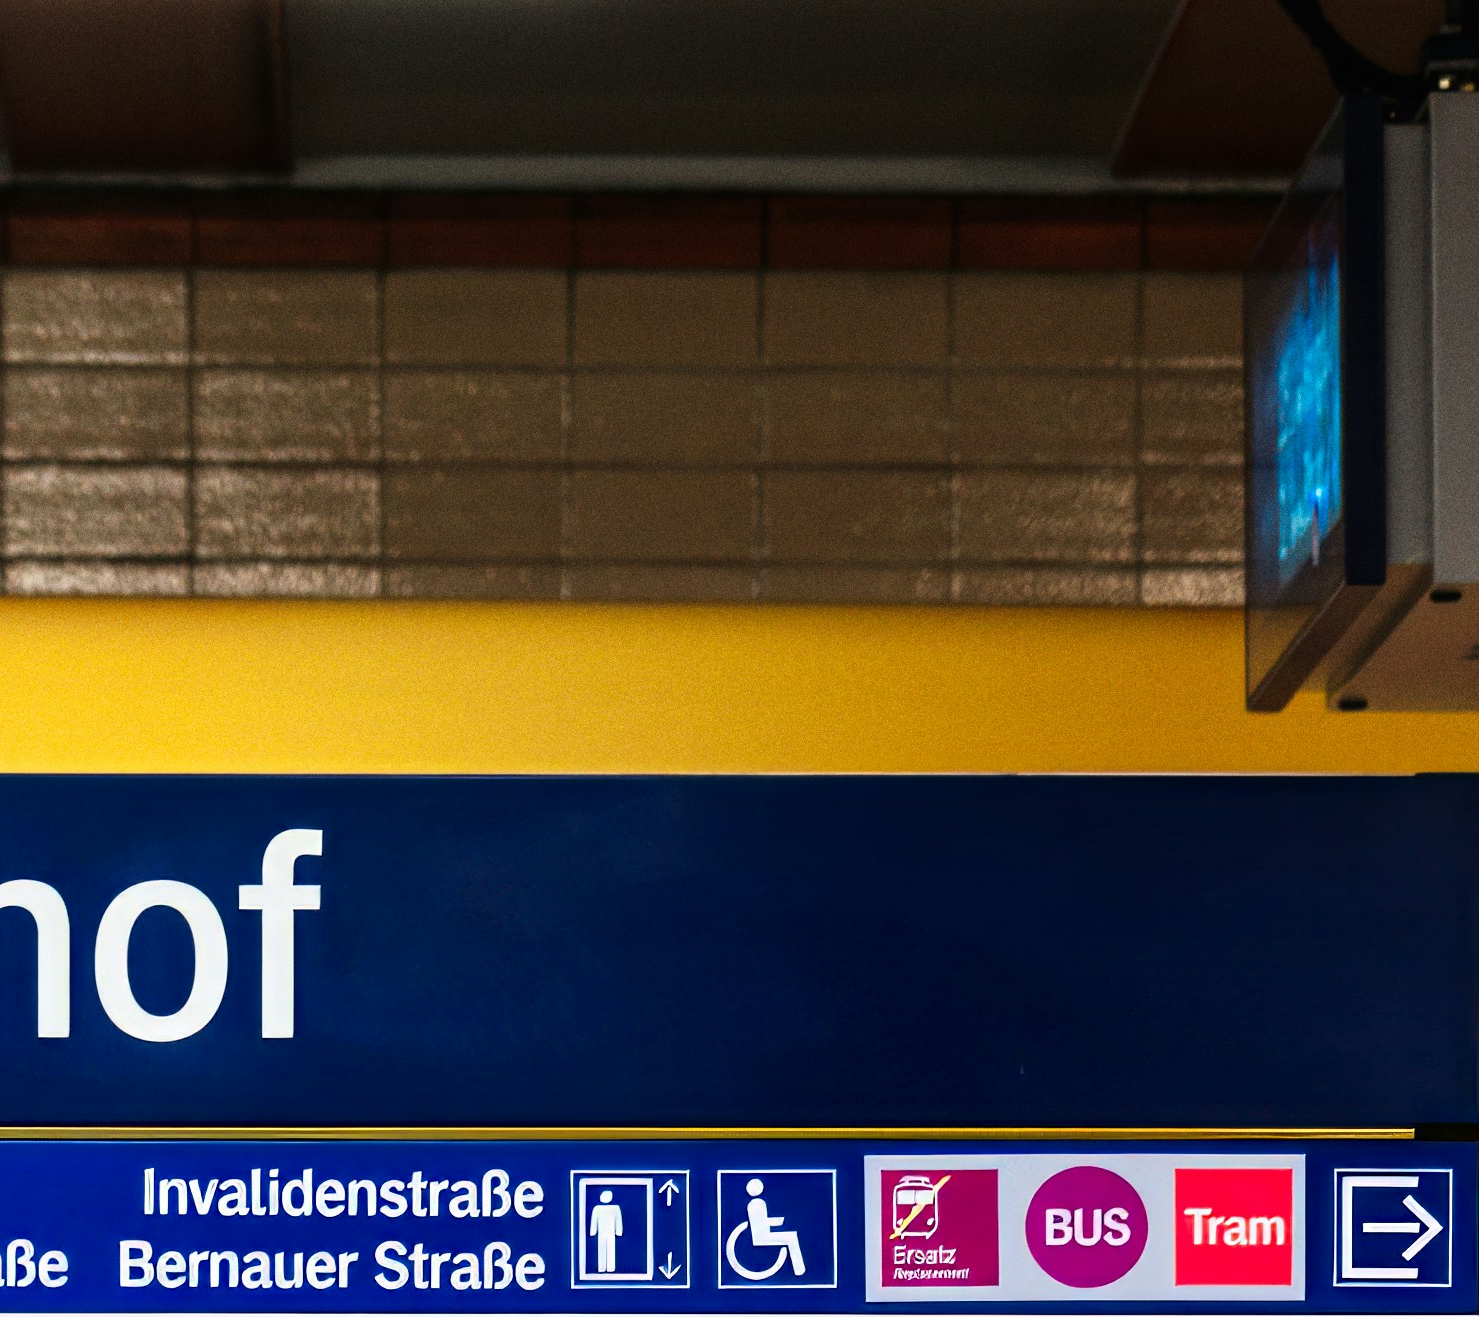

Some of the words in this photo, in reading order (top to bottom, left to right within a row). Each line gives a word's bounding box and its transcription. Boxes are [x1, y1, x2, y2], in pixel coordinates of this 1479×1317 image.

[142, 1166, 545, 1220] Invalidenstraße
[1045, 1207, 1132, 1247] BUS
[1183, 1207, 1285, 1246] Tram
[118, 1238, 360, 1290] Bernauer
[372, 1238, 547, 1292] Straße
[892, 1244, 957, 1265] Ersatz
